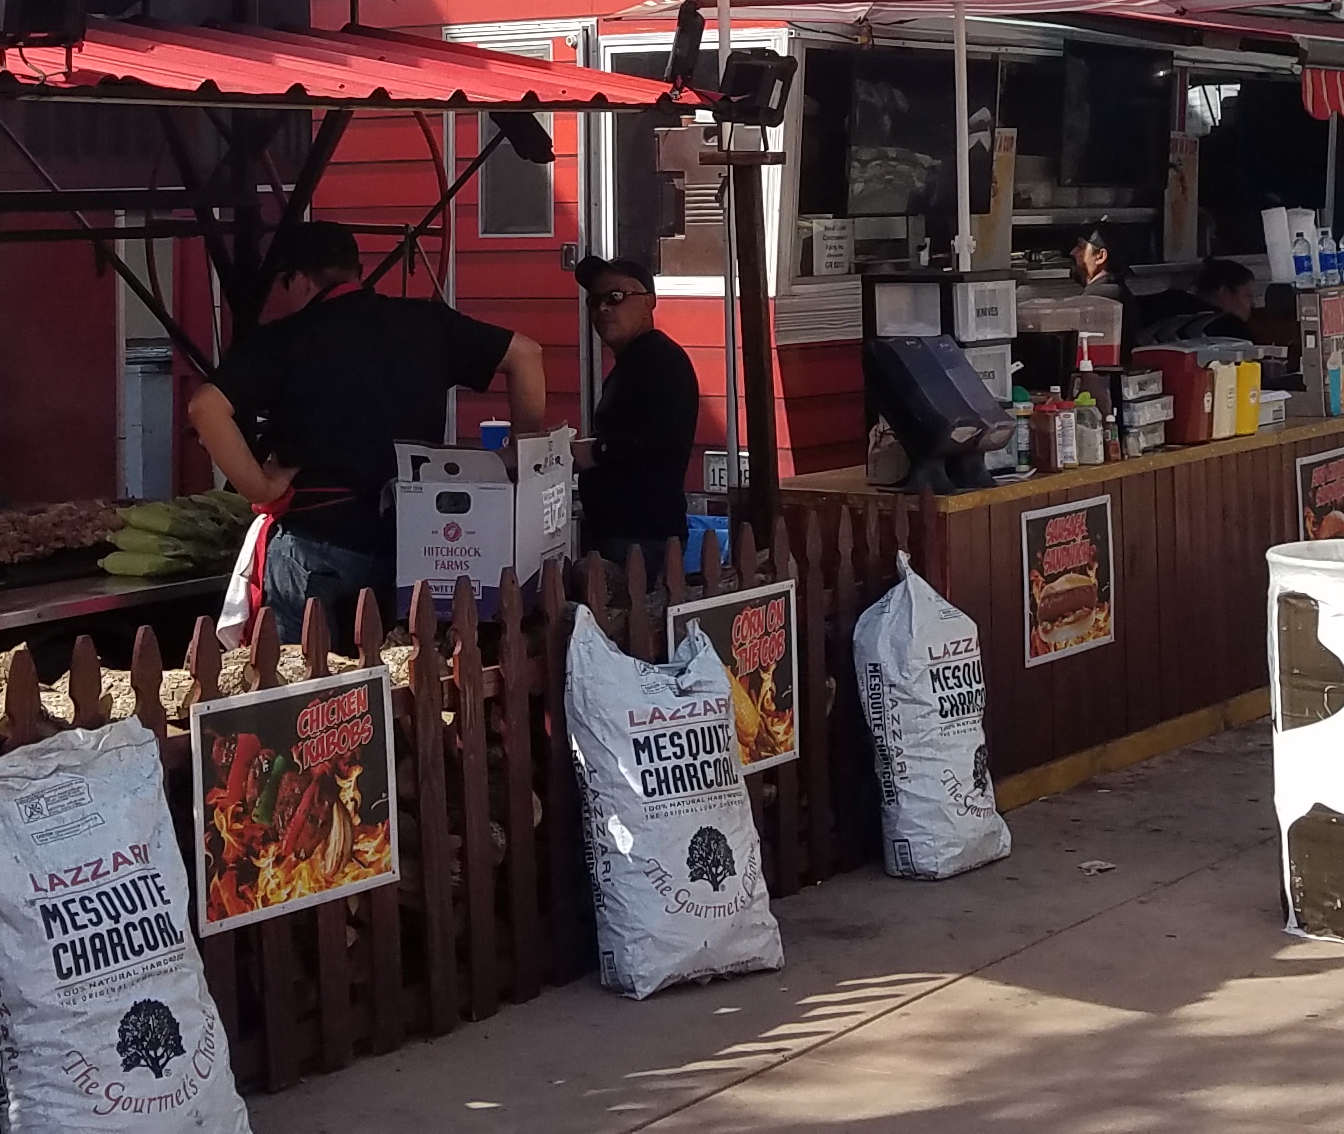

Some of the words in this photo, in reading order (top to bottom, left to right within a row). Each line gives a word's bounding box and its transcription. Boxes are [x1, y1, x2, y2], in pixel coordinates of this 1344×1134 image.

[423, 547, 481, 557] HITCHCOCK
[435, 560, 470, 570] FARMS
[732, 605, 766, 645] CORN
[767, 596, 785, 632] ON
[737, 639, 759, 677] THE
[760, 629, 785, 666] COB
[297, 684, 368, 738] CHICKEN
[867, 663, 883, 733] MESQUITE
[303, 714, 373, 770] KABOBS
[632, 724, 732, 766] MESQUITE
[887, 684, 908, 782] LAZZARI
[640, 756, 739, 798] CHARCOAL
[941, 768, 963, 802] The
[587, 768, 613, 885] LAZZARI
[29, 844, 150, 892] LAZZARI
[643, 858, 673, 897] The
[665, 888, 746, 918] Gourmet's
[39, 873, 171, 940] MESQUITE
[52, 911, 185, 981] CHARCOAL
[88, 969, 138, 989] NATURAL
[61, 1050, 100, 1095] The
[93, 1074, 199, 1116] Gourmet's
